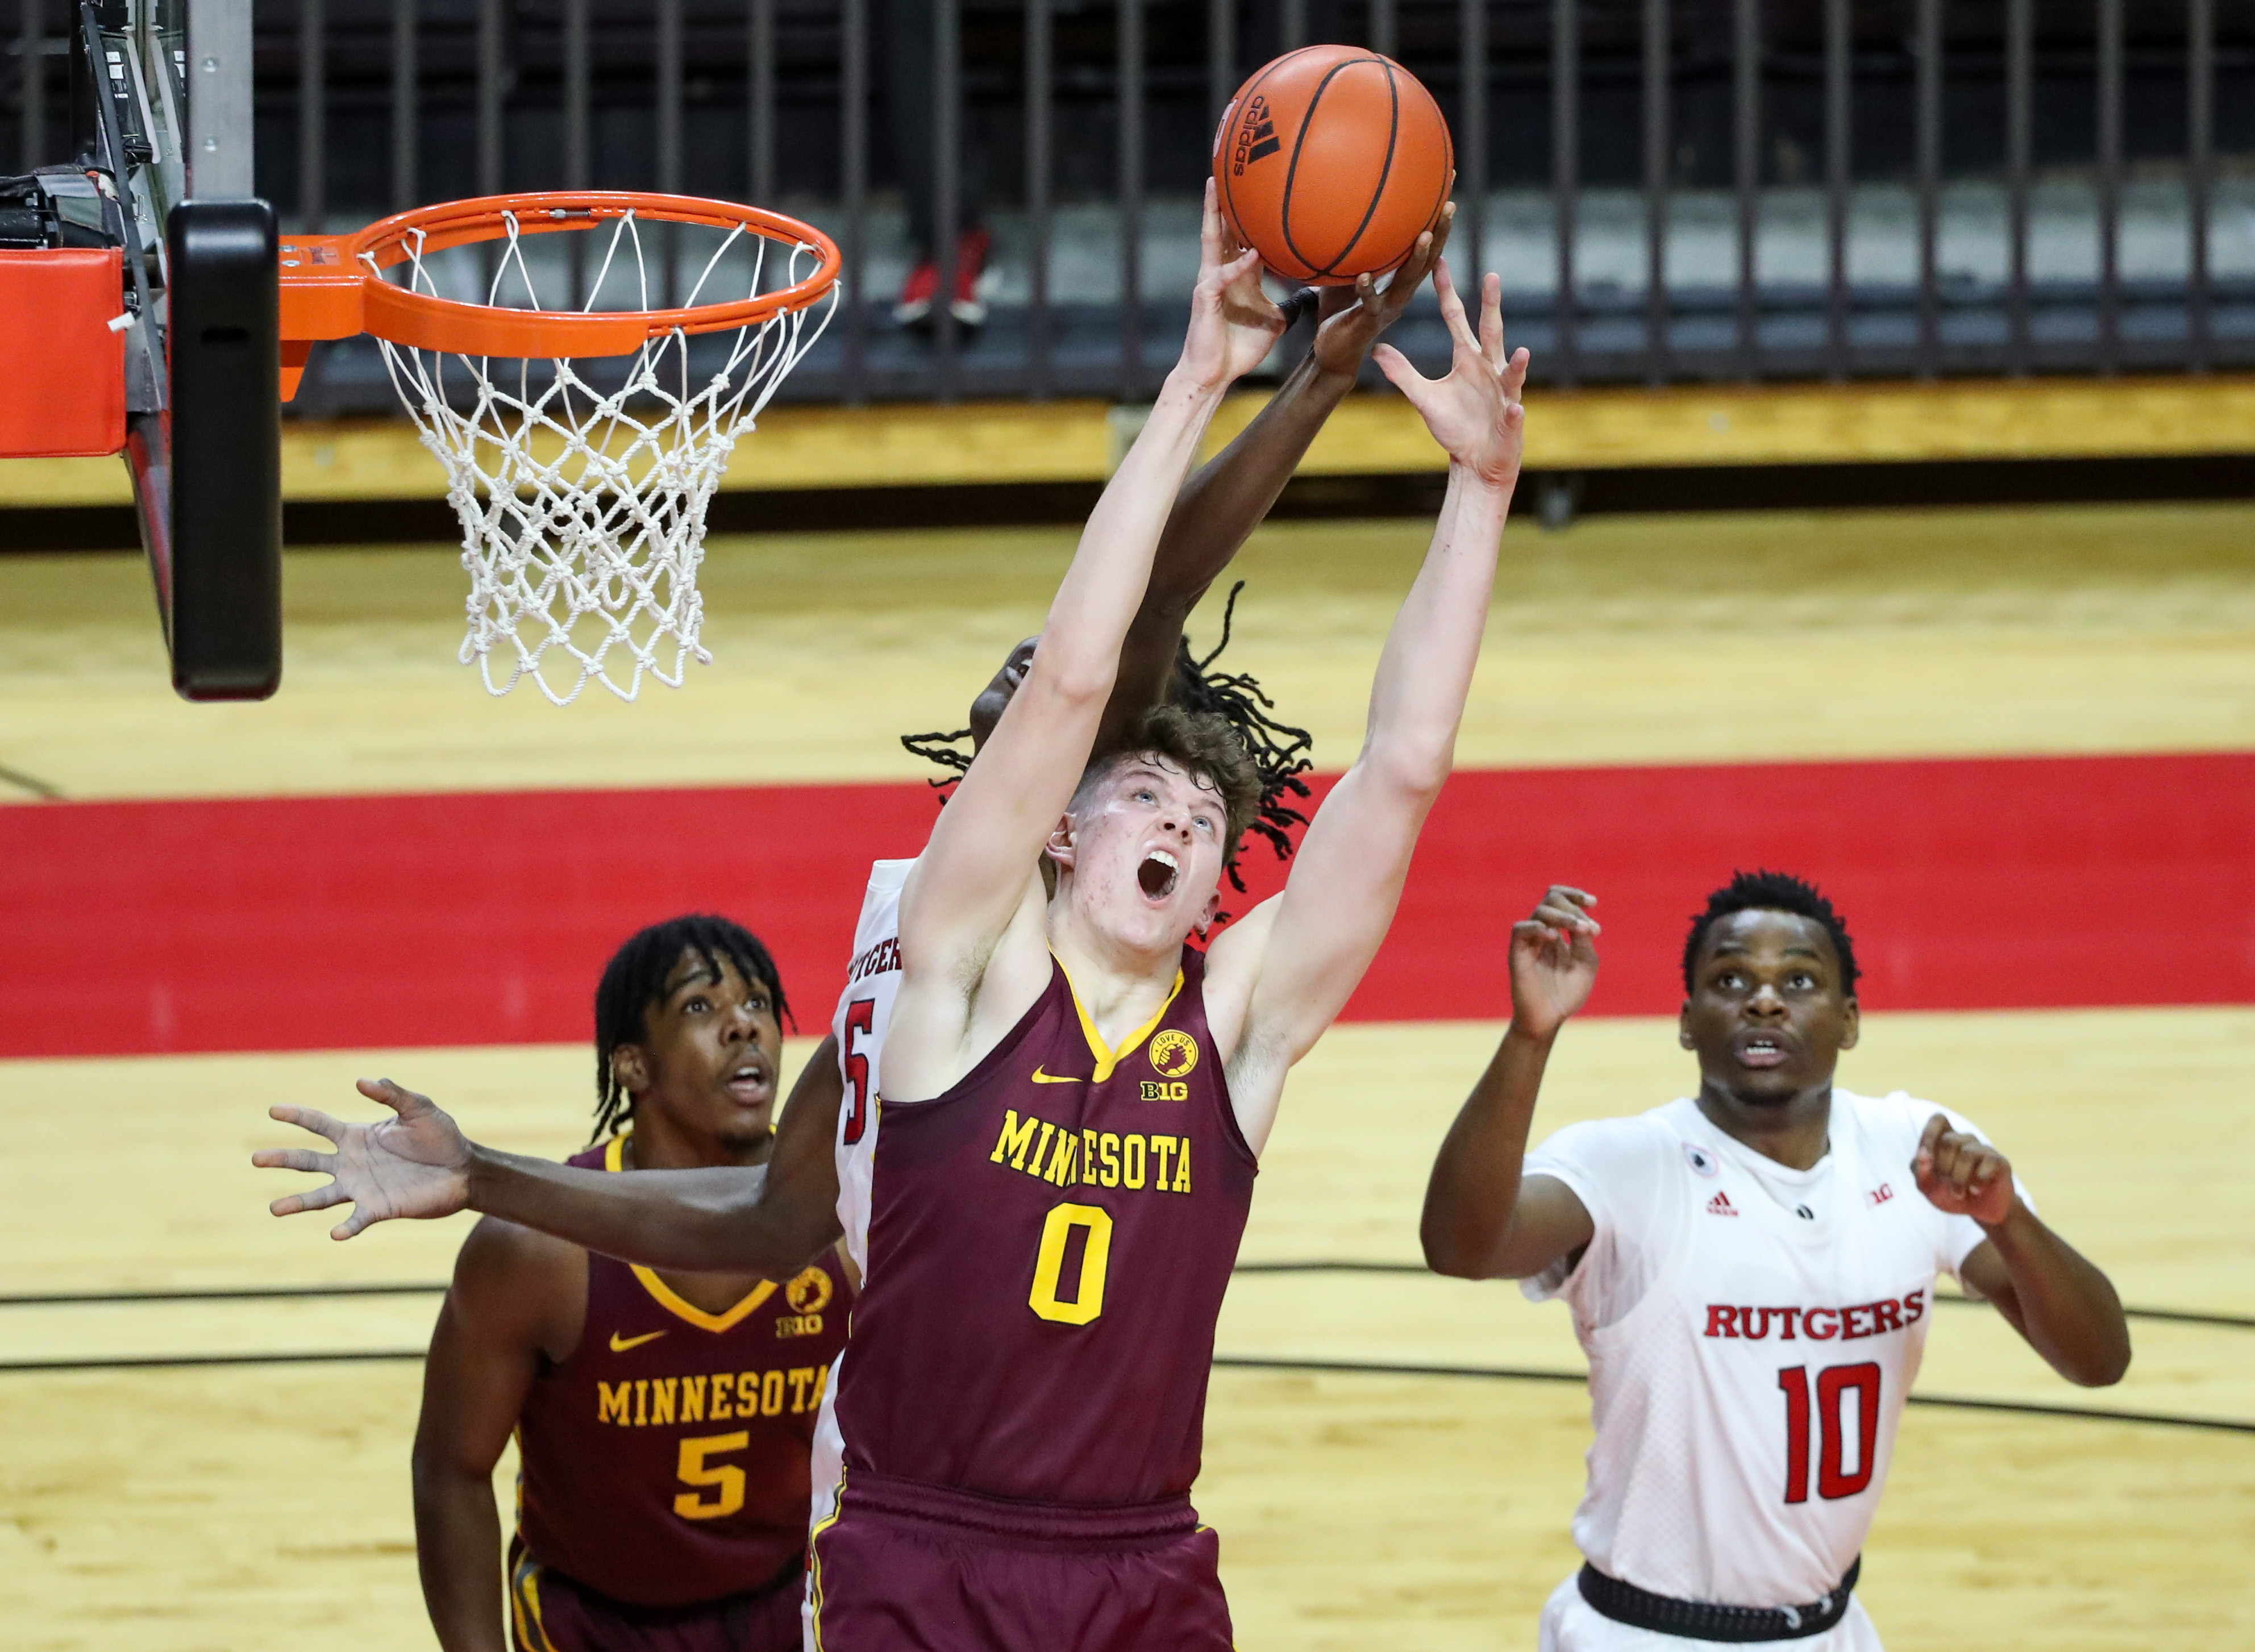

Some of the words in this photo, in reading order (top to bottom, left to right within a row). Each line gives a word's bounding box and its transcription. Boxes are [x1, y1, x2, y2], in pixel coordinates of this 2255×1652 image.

[1233, 95, 1264, 177] adidas
[843, 998, 875, 1146] 5
[1156, 1034, 1175, 1046] LOVE
[1179, 1037, 1190, 1046] US
[1028, 1202, 1113, 1326] 0
[1704, 1289, 1924, 1341] RUTGERS
[673, 1430, 750, 1520] 5
[1778, 1362, 1881, 1504] 10
